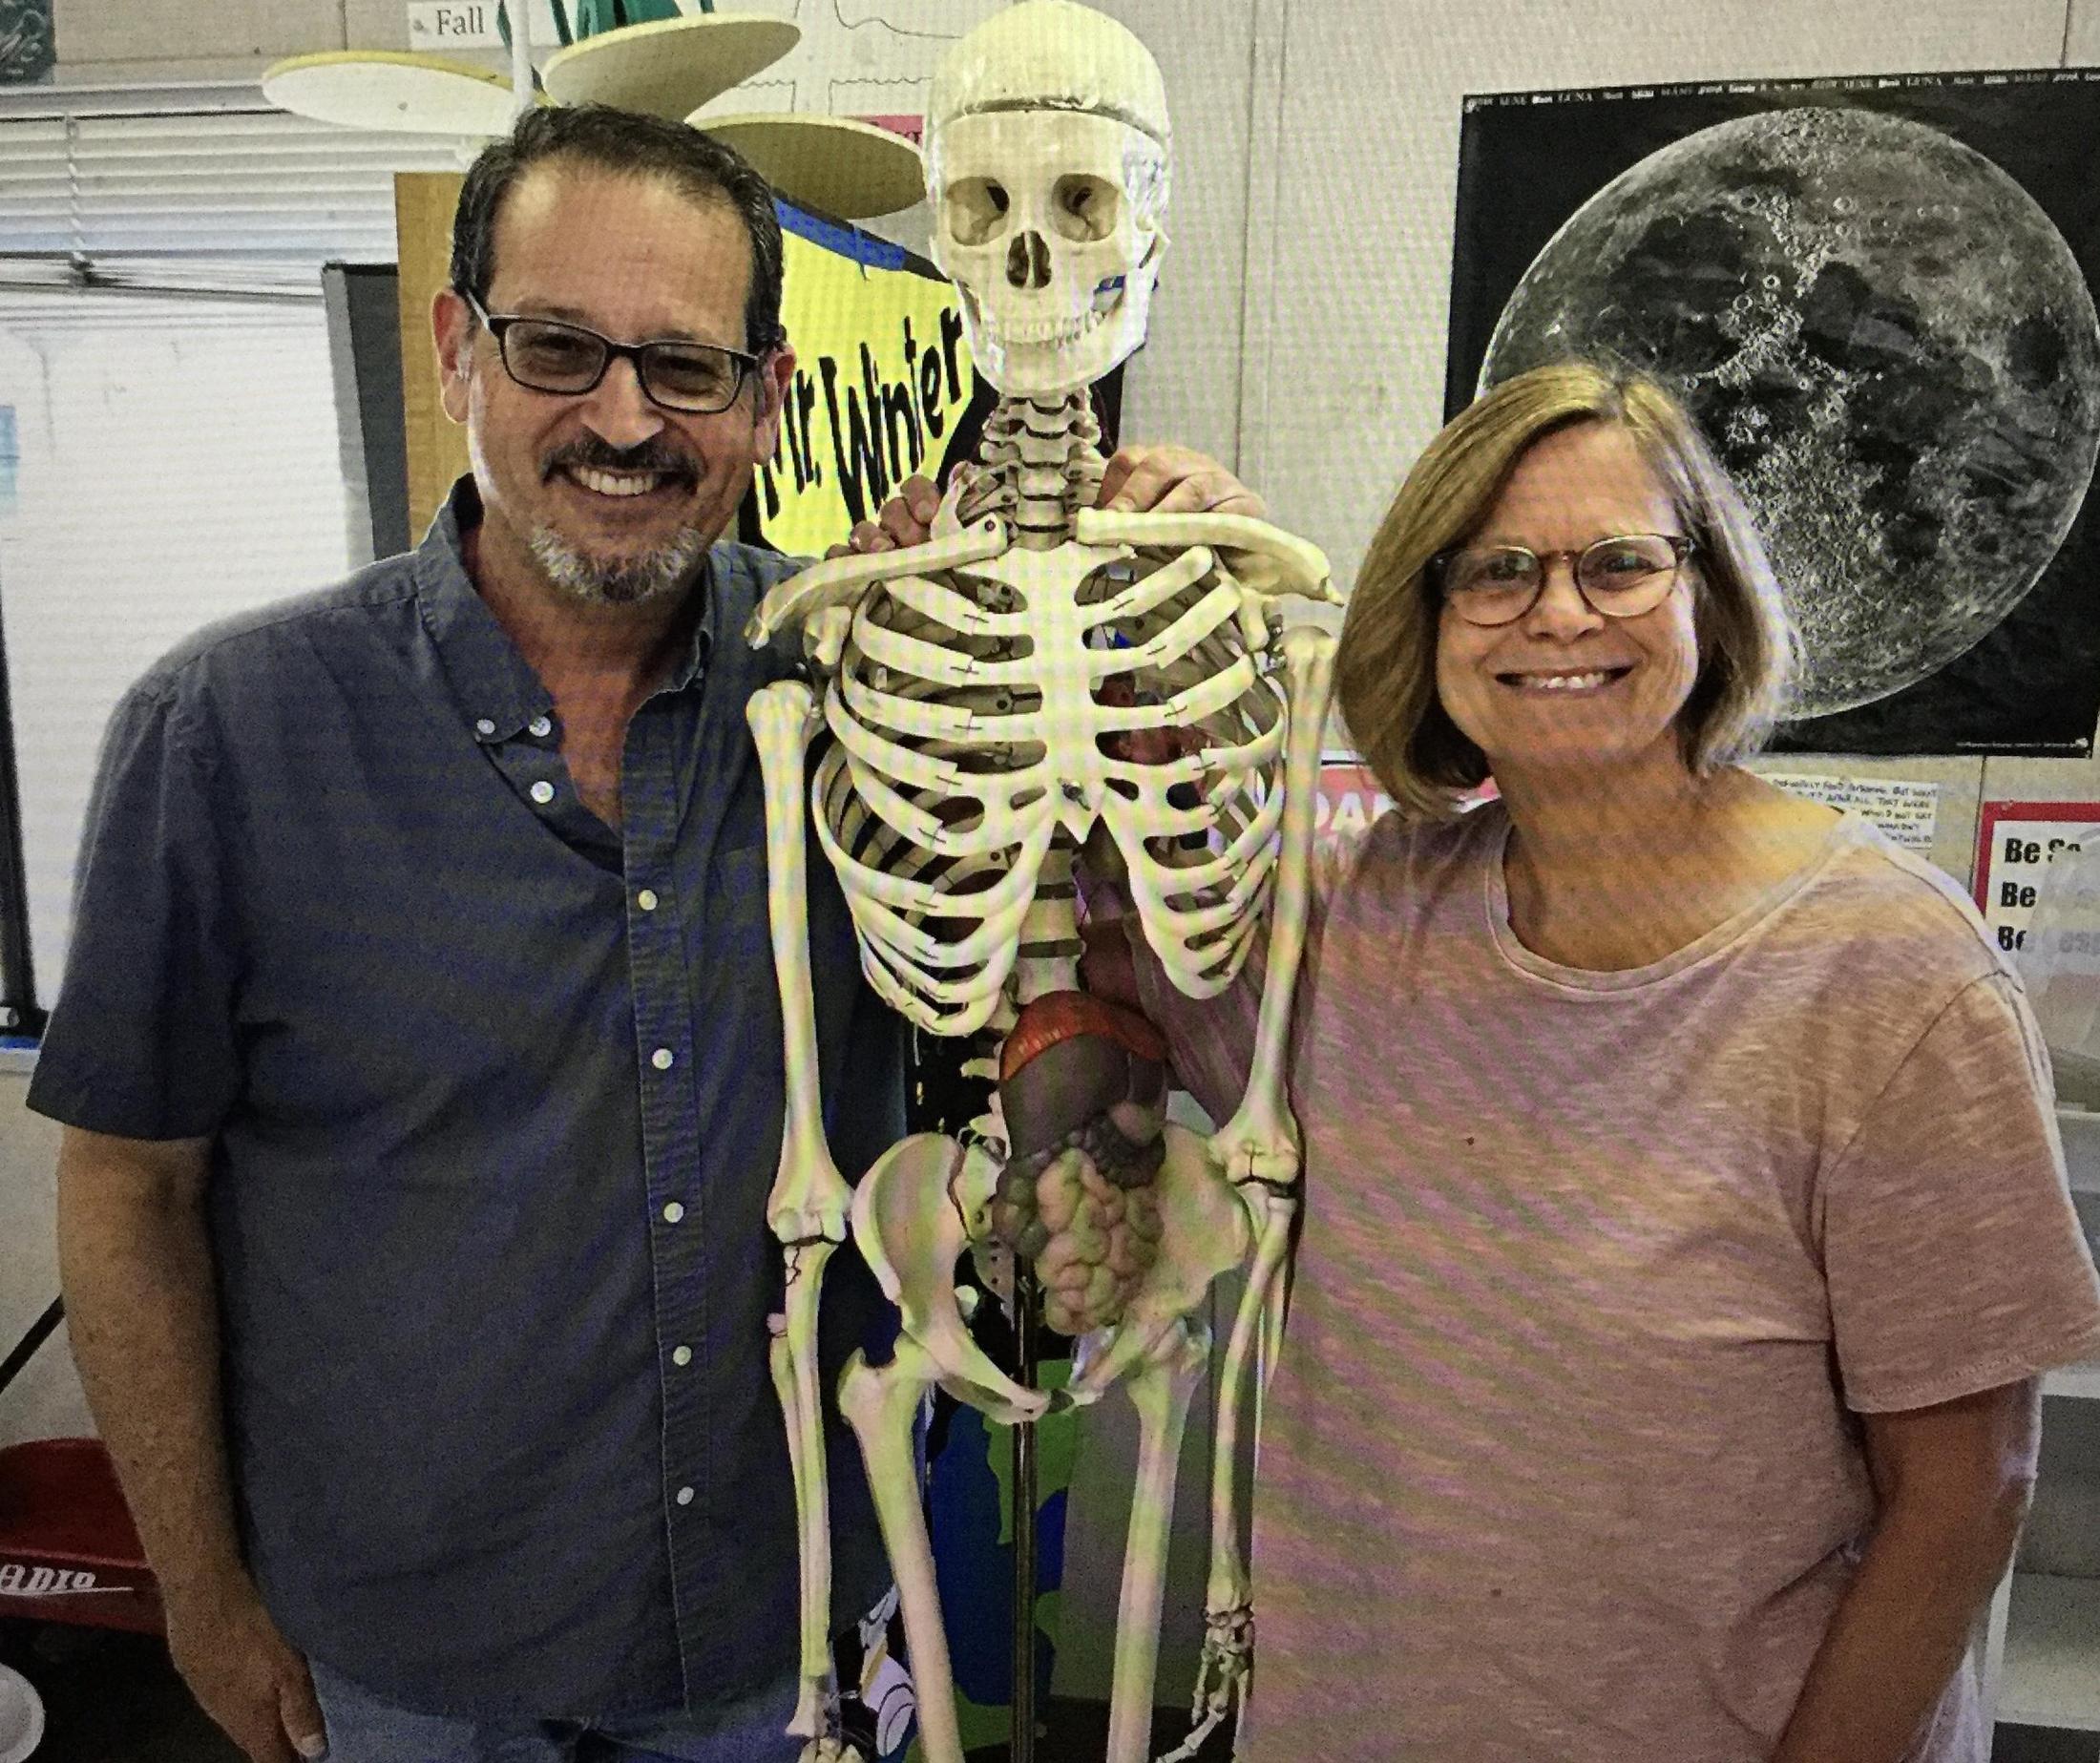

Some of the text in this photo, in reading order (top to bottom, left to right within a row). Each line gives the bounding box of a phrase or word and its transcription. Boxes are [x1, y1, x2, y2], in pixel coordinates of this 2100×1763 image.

[436, 7, 484, 35] Fall
[2004, 837, 2041, 864] Be
[2000, 881, 2037, 908] Be
